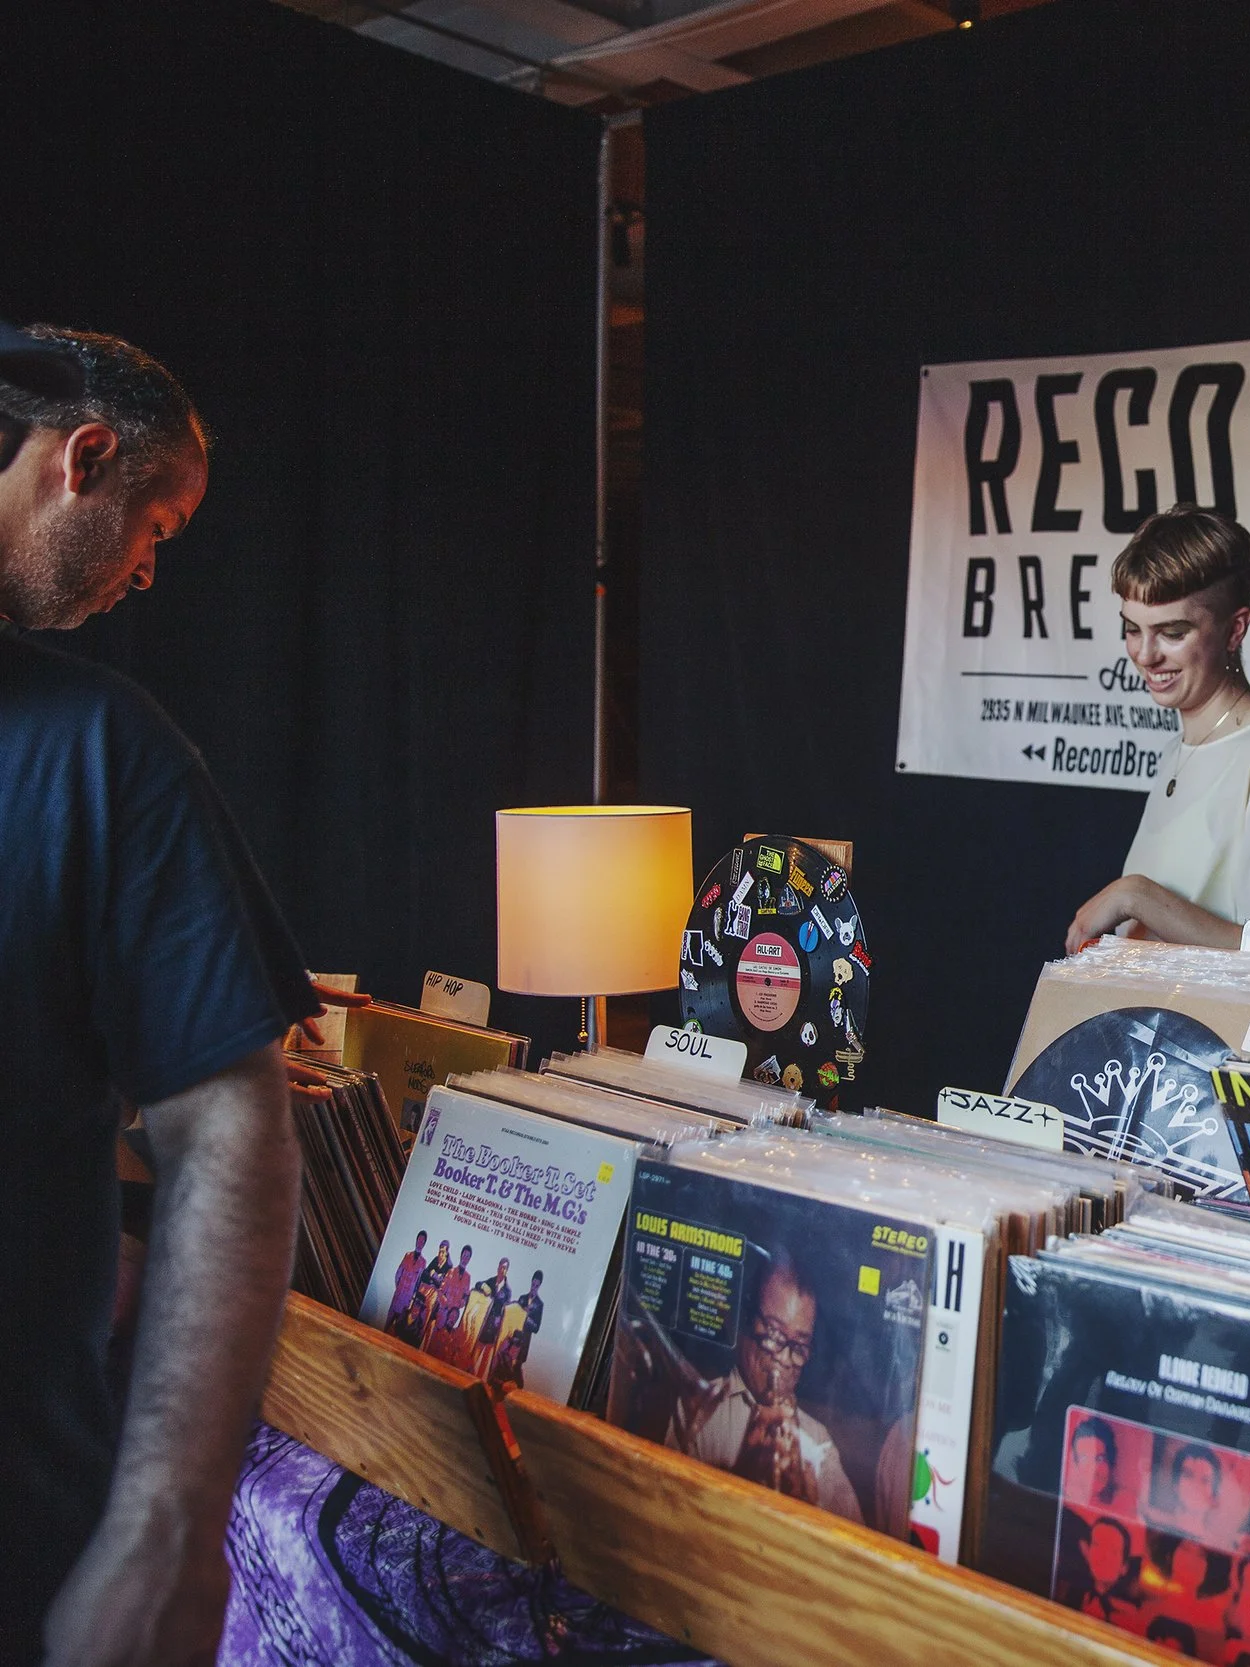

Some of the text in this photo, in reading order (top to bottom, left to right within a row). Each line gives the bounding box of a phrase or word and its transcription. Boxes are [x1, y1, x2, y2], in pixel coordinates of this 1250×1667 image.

[1013, 701, 1025, 722] N
[1026, 702, 1101, 726] MILWAUKEE
[426, 973, 463, 997] HIP HOP
[664, 1029, 713, 1060] SOUL
[950, 1090, 1034, 1124] JAZZ
[433, 1157, 485, 1190] Booker
[485, 1173, 499, 1196] T.
[498, 1179, 514, 1199] &
[514, 1182, 542, 1210] The
[441, 1134, 476, 1164] The
[475, 1144, 544, 1186] Booker
[543, 1165, 560, 1192] T.
[561, 1172, 597, 1203] Set
[636, 1212, 743, 1257] LOUIS ARMSTRONG
[872, 1225, 928, 1251] STEREO
